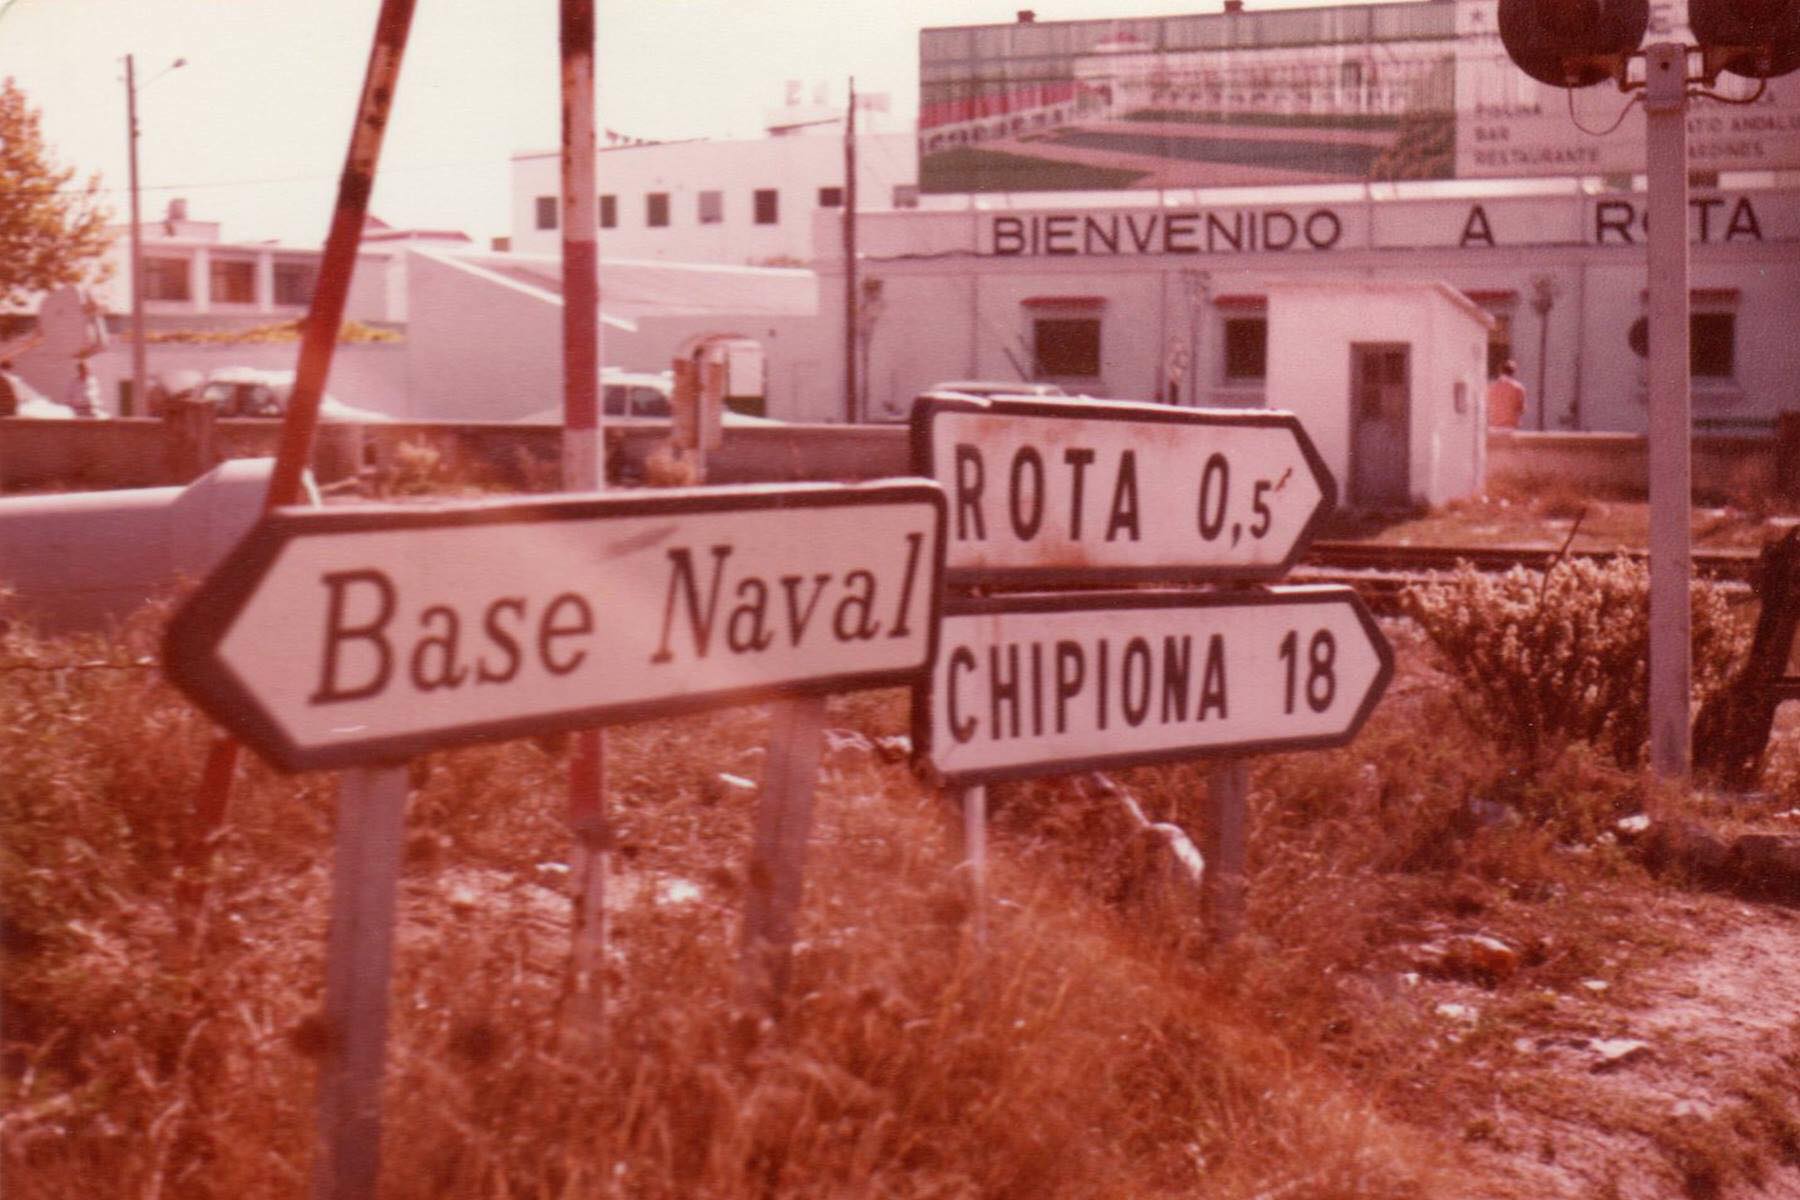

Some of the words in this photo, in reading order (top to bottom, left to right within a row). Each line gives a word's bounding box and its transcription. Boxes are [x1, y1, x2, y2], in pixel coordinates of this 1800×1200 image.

[1474, 147, 1600, 166] RESTAURANTE
[1475, 126, 1510, 142] BAR
[1686, 142, 1765, 159] ARDINES
[993, 207, 1343, 256] BIENVENIDO
[1459, 204, 1495, 248] A
[1595, 197, 1763, 245] RTA
[955, 443, 1141, 543] ROTA
[1198, 451, 1273, 549] 0,5
[307, 567, 595, 707] Base
[650, 531, 925, 666] Naval
[946, 632, 1228, 745] CHIPIONA
[1278, 627, 1337, 716] 18
